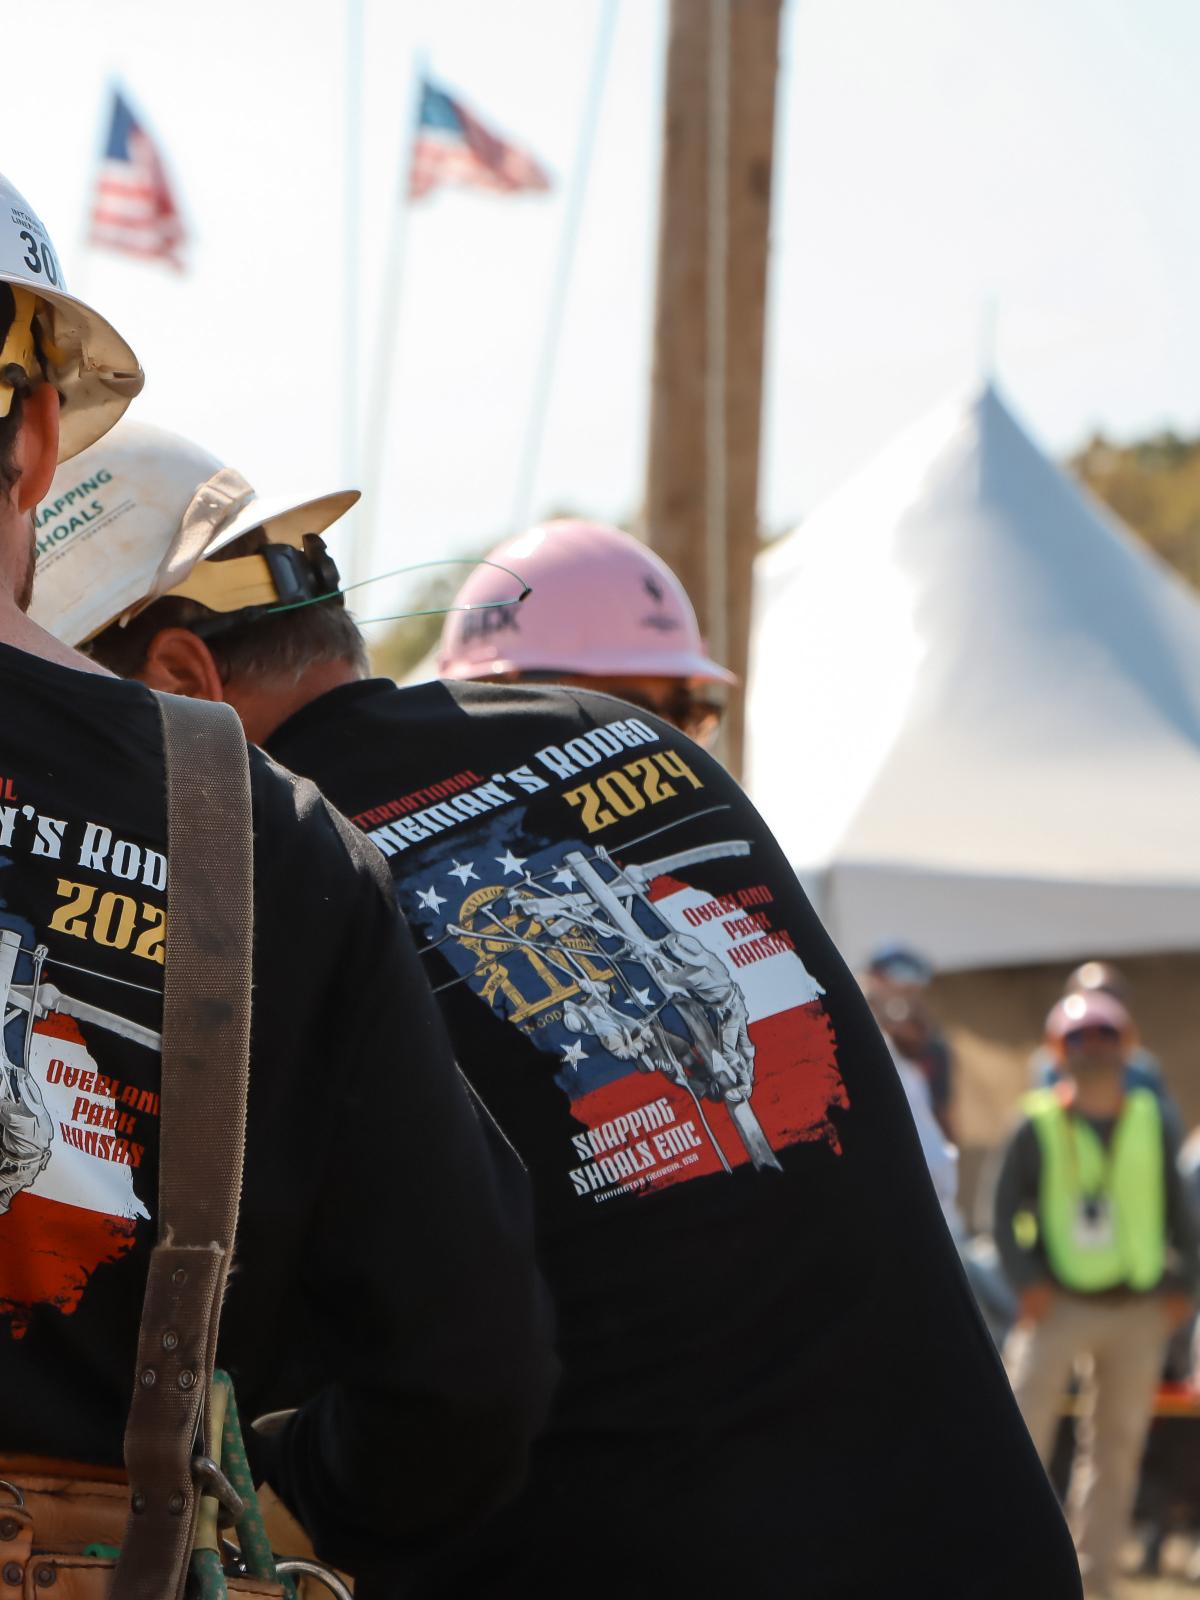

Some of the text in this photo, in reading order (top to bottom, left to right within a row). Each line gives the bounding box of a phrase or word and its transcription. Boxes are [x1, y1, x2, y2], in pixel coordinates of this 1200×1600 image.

[20, 231, 60, 288] 30
[35, 467, 112, 528] APPING
[351, 769, 484, 829] TERNATIONAL
[366, 717, 660, 858] NEMAN'S RODEO
[562, 749, 705, 834] 2024
[77, 821, 168, 892] ROD
[48, 878, 167, 965] 202
[682, 885, 774, 928] OVERLAND
[722, 911, 773, 941] PARK
[726, 929, 797, 969] KANSAS
[59, 1121, 145, 1168] KANSAS
[71, 1097, 136, 1135] PARK
[571, 1097, 676, 1161] SNAPPING
[569, 1120, 702, 1196] SHOALS EMC
[681, 1153, 699, 1166] USA
